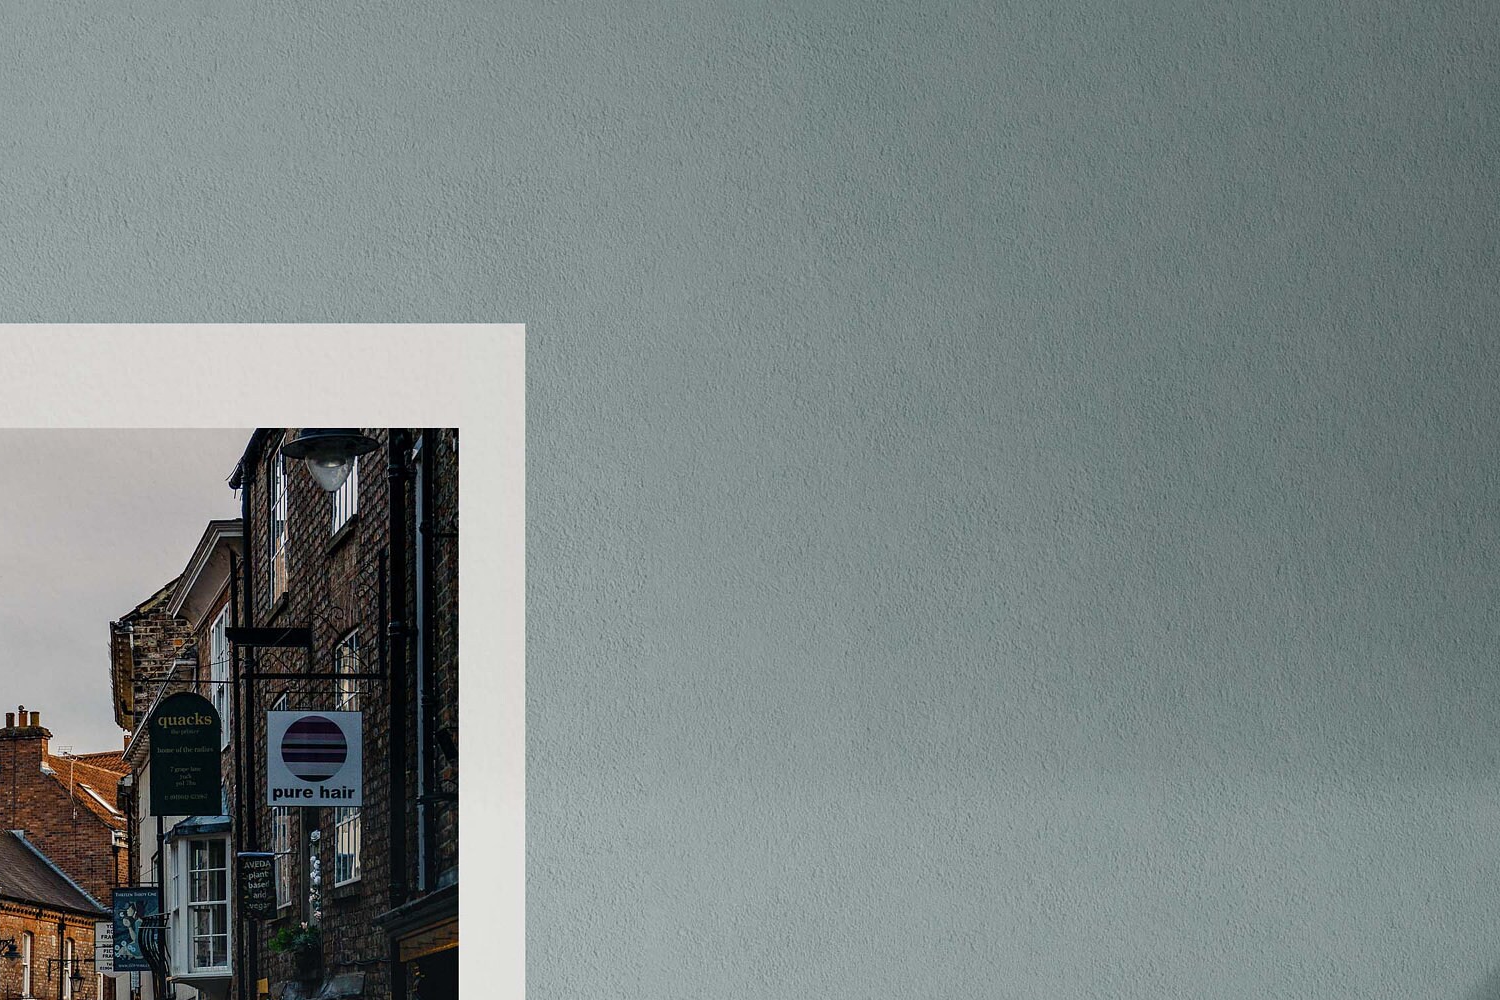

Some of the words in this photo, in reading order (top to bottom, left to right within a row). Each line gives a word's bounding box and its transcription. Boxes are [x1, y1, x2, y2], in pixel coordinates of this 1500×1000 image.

[158, 712, 213, 729] quacks
[273, 788, 313, 801] pure
[320, 786, 355, 799] hair
[244, 860, 272, 869] AVEDA
[248, 871, 269, 880] plant
[248, 880, 270, 889] based
[253, 890, 267, 899] and
